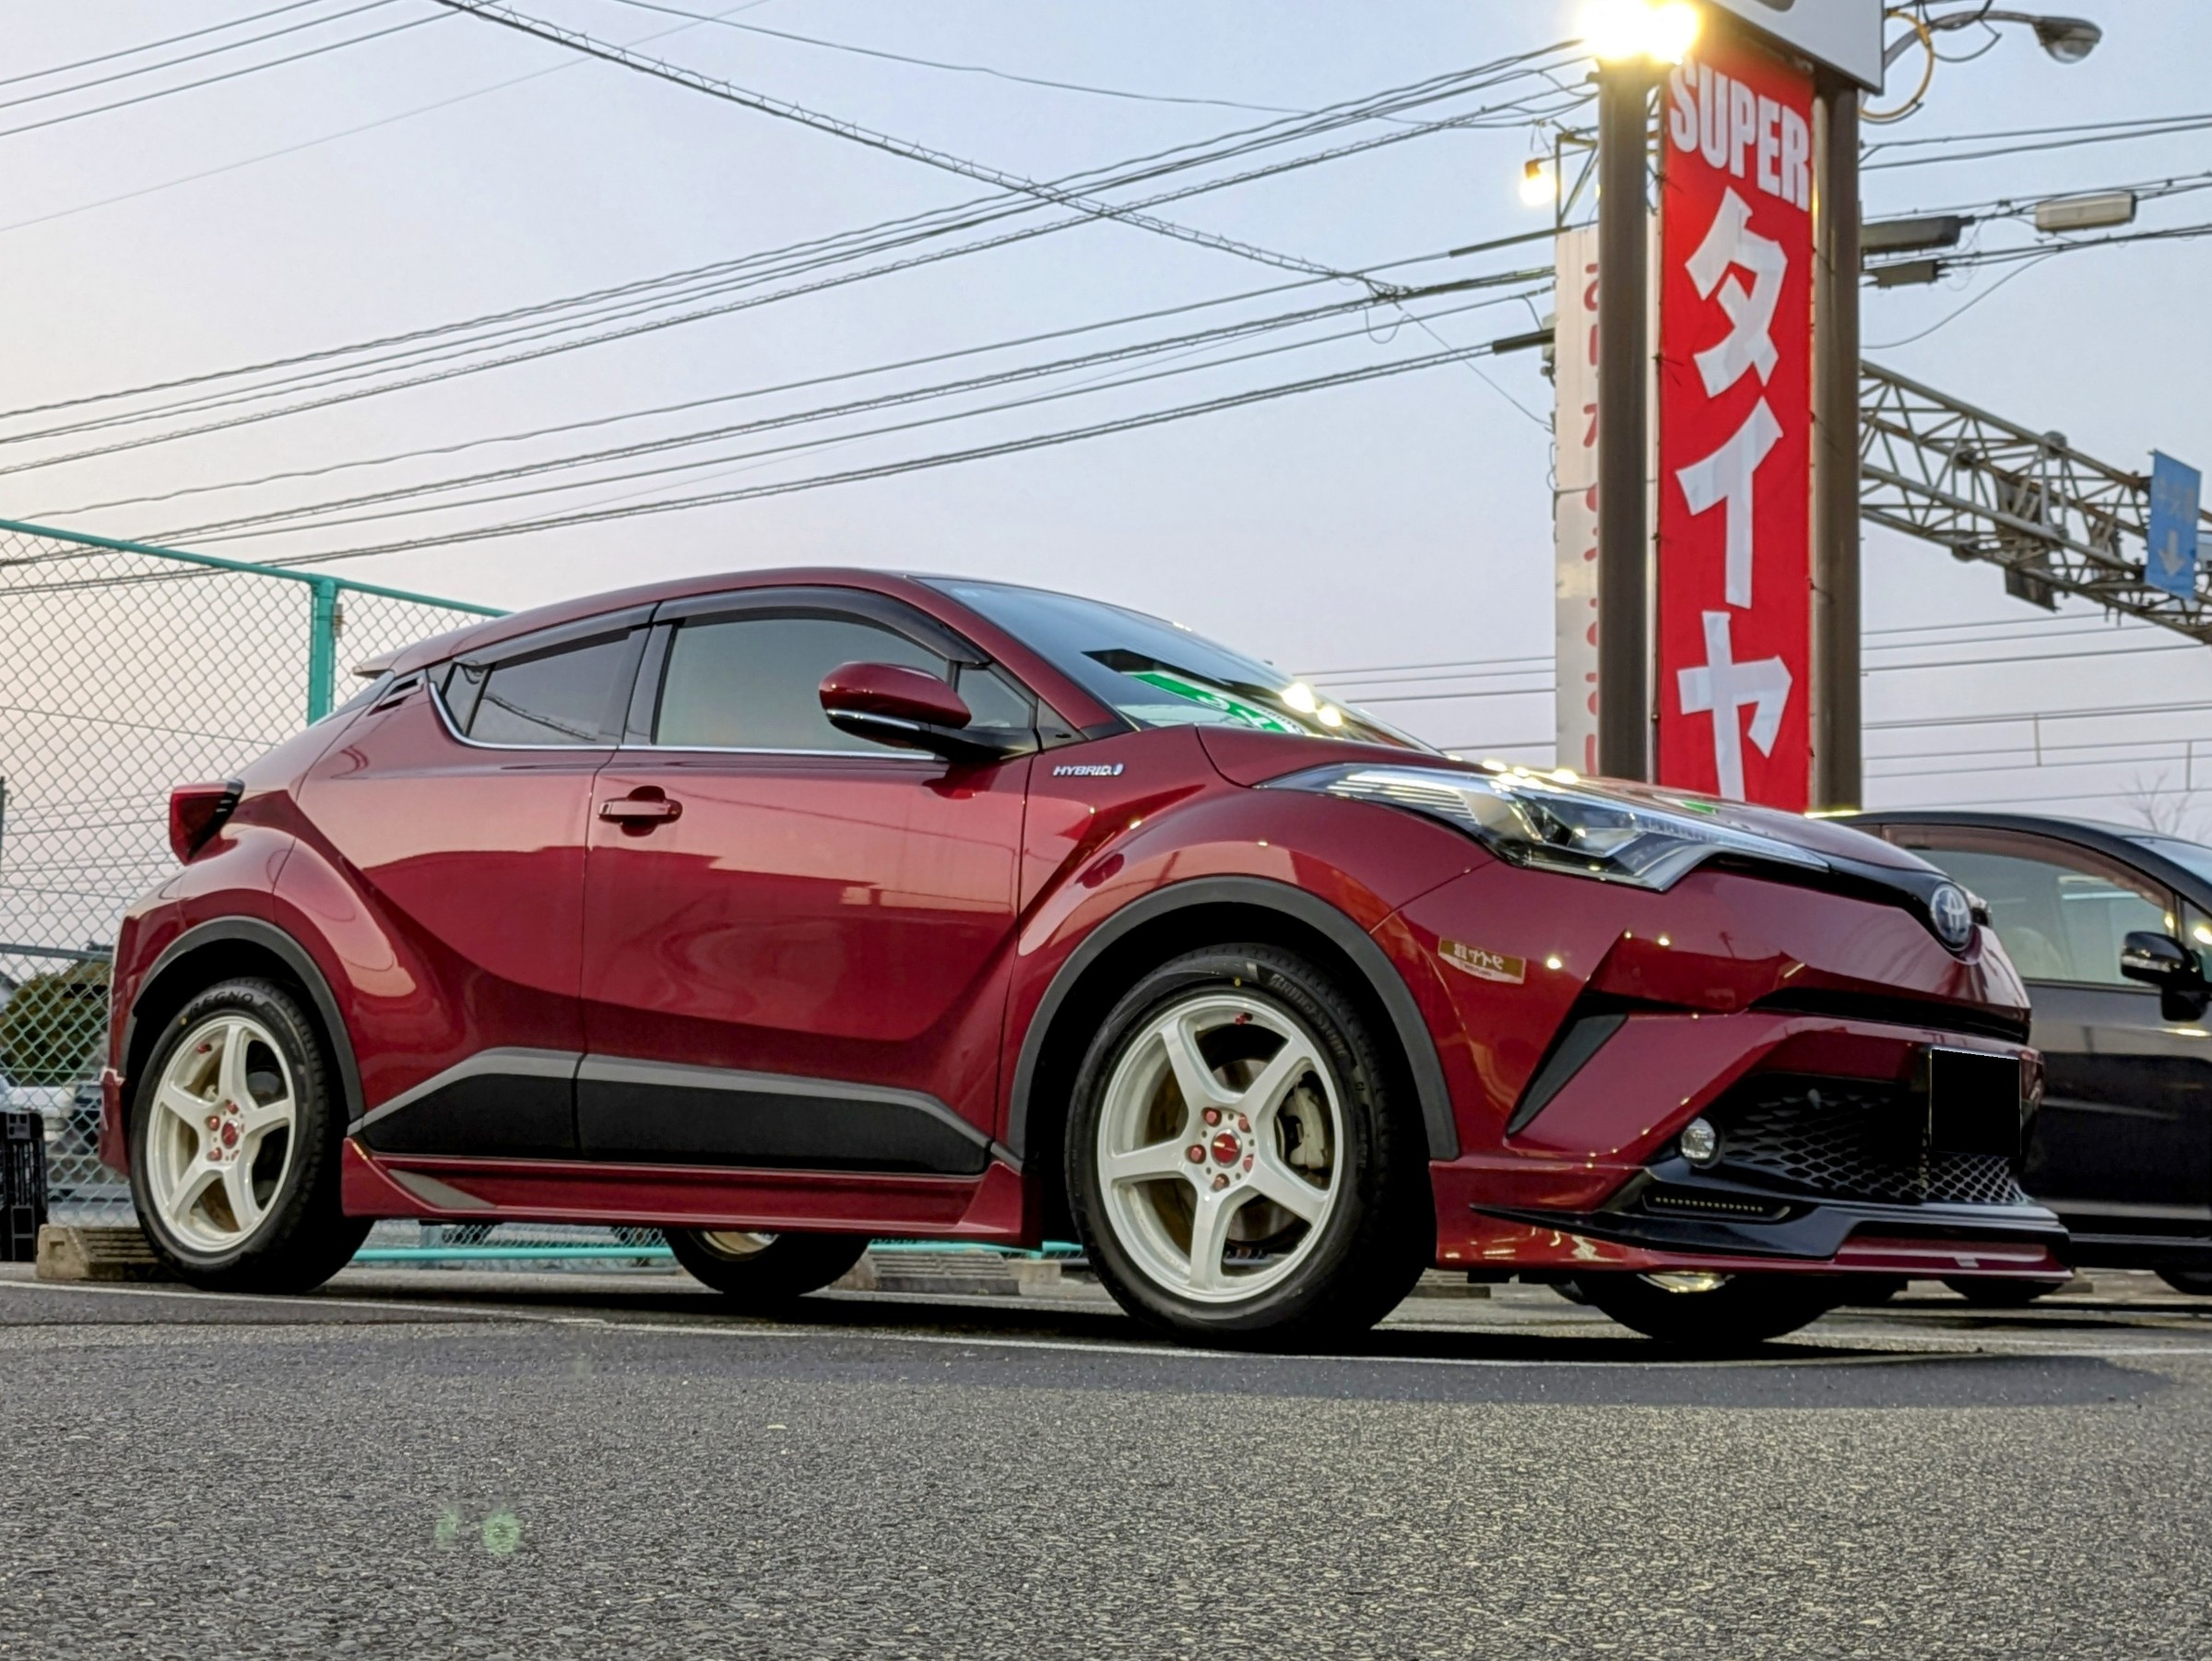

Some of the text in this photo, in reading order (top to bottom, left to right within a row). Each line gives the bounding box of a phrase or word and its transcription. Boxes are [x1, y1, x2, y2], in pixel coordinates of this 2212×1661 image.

[1669, 54, 1810, 213] SUPER
[1674, 184, 1793, 802] タイヤ
[1052, 764, 1113, 777] HYBRID
